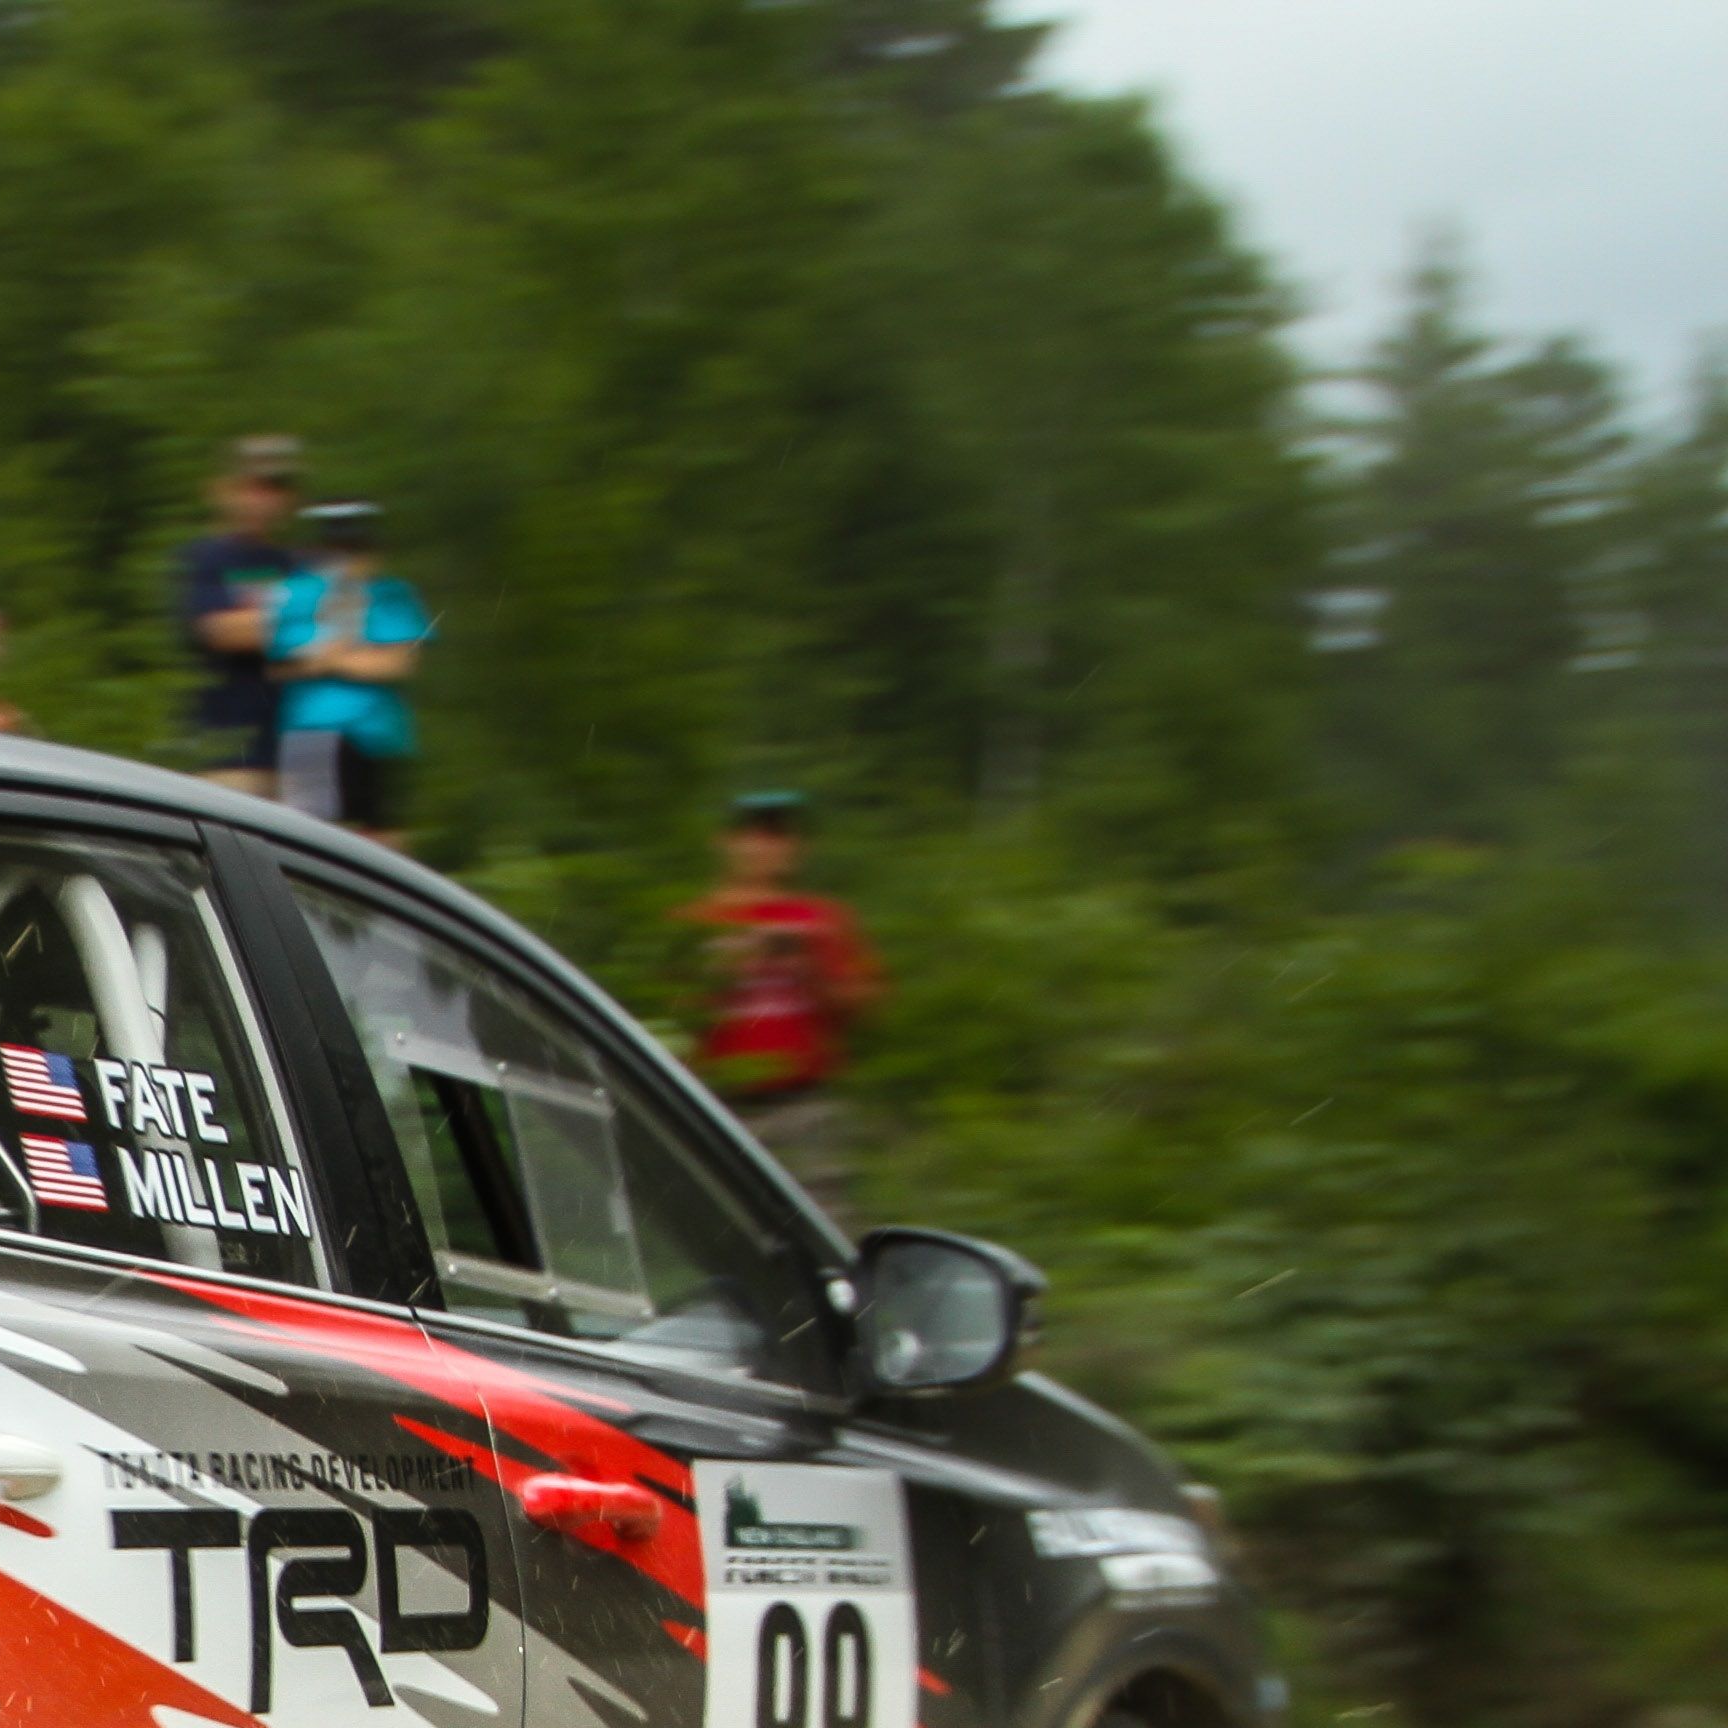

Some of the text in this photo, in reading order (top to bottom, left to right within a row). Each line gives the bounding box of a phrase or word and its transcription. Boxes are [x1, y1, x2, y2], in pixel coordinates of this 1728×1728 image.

[94, 1057, 228, 1144] FATE
[116, 1144, 312, 1238] MILLEN
[209, 1452, 304, 1492] RACING
[309, 1452, 478, 1493] DEVELOPMENT
[108, 1507, 490, 1715] TRD
